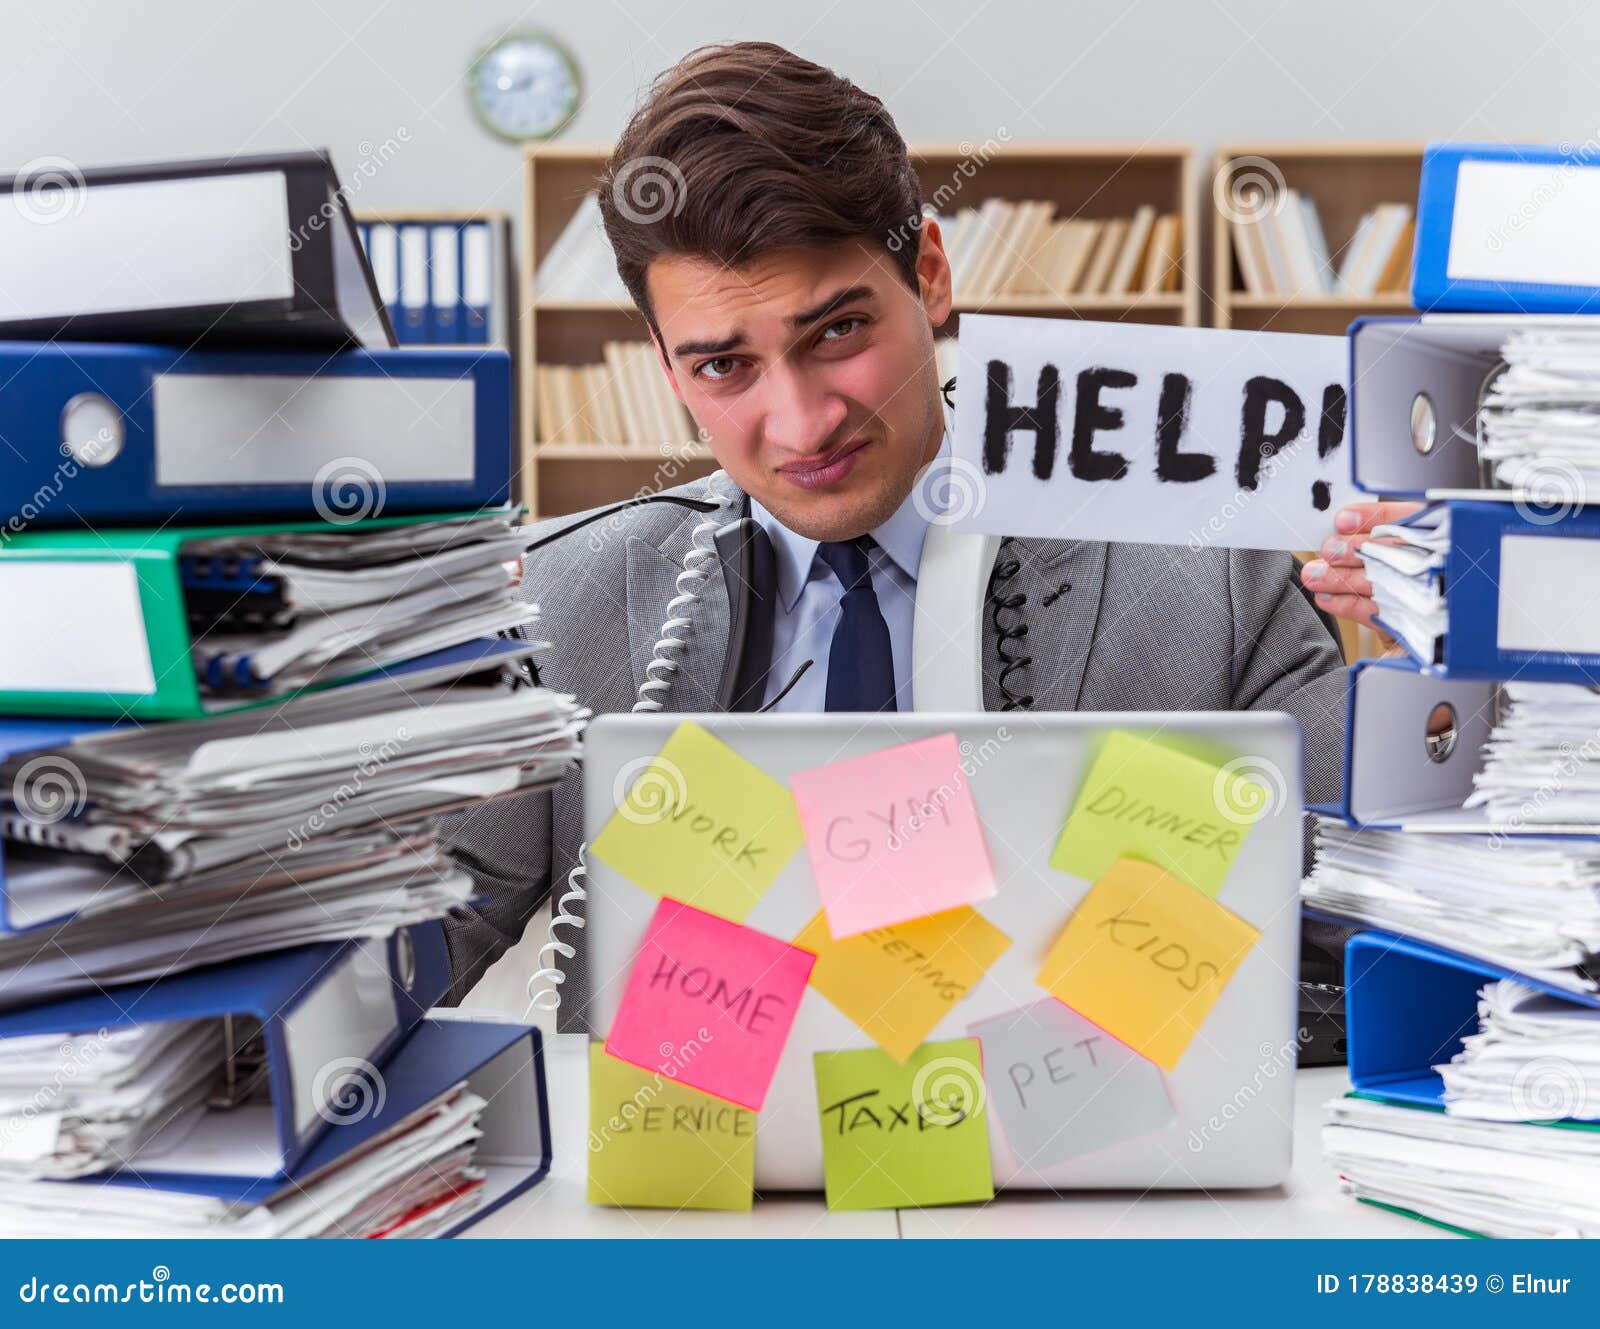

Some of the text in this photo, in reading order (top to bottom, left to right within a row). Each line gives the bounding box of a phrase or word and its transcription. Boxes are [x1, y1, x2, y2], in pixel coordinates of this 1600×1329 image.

[983, 359, 1347, 511] HELP!
[660, 800, 768, 869] WORK
[825, 789, 950, 862] GYM
[1085, 785, 1240, 862] DINNER
[862, 927, 967, 1001] EETING
[1096, 903, 1219, 991] KIDS
[649, 954, 787, 1036] HOME
[1007, 1036, 1101, 1110] PET
[820, 1089, 967, 1135] TAXES
